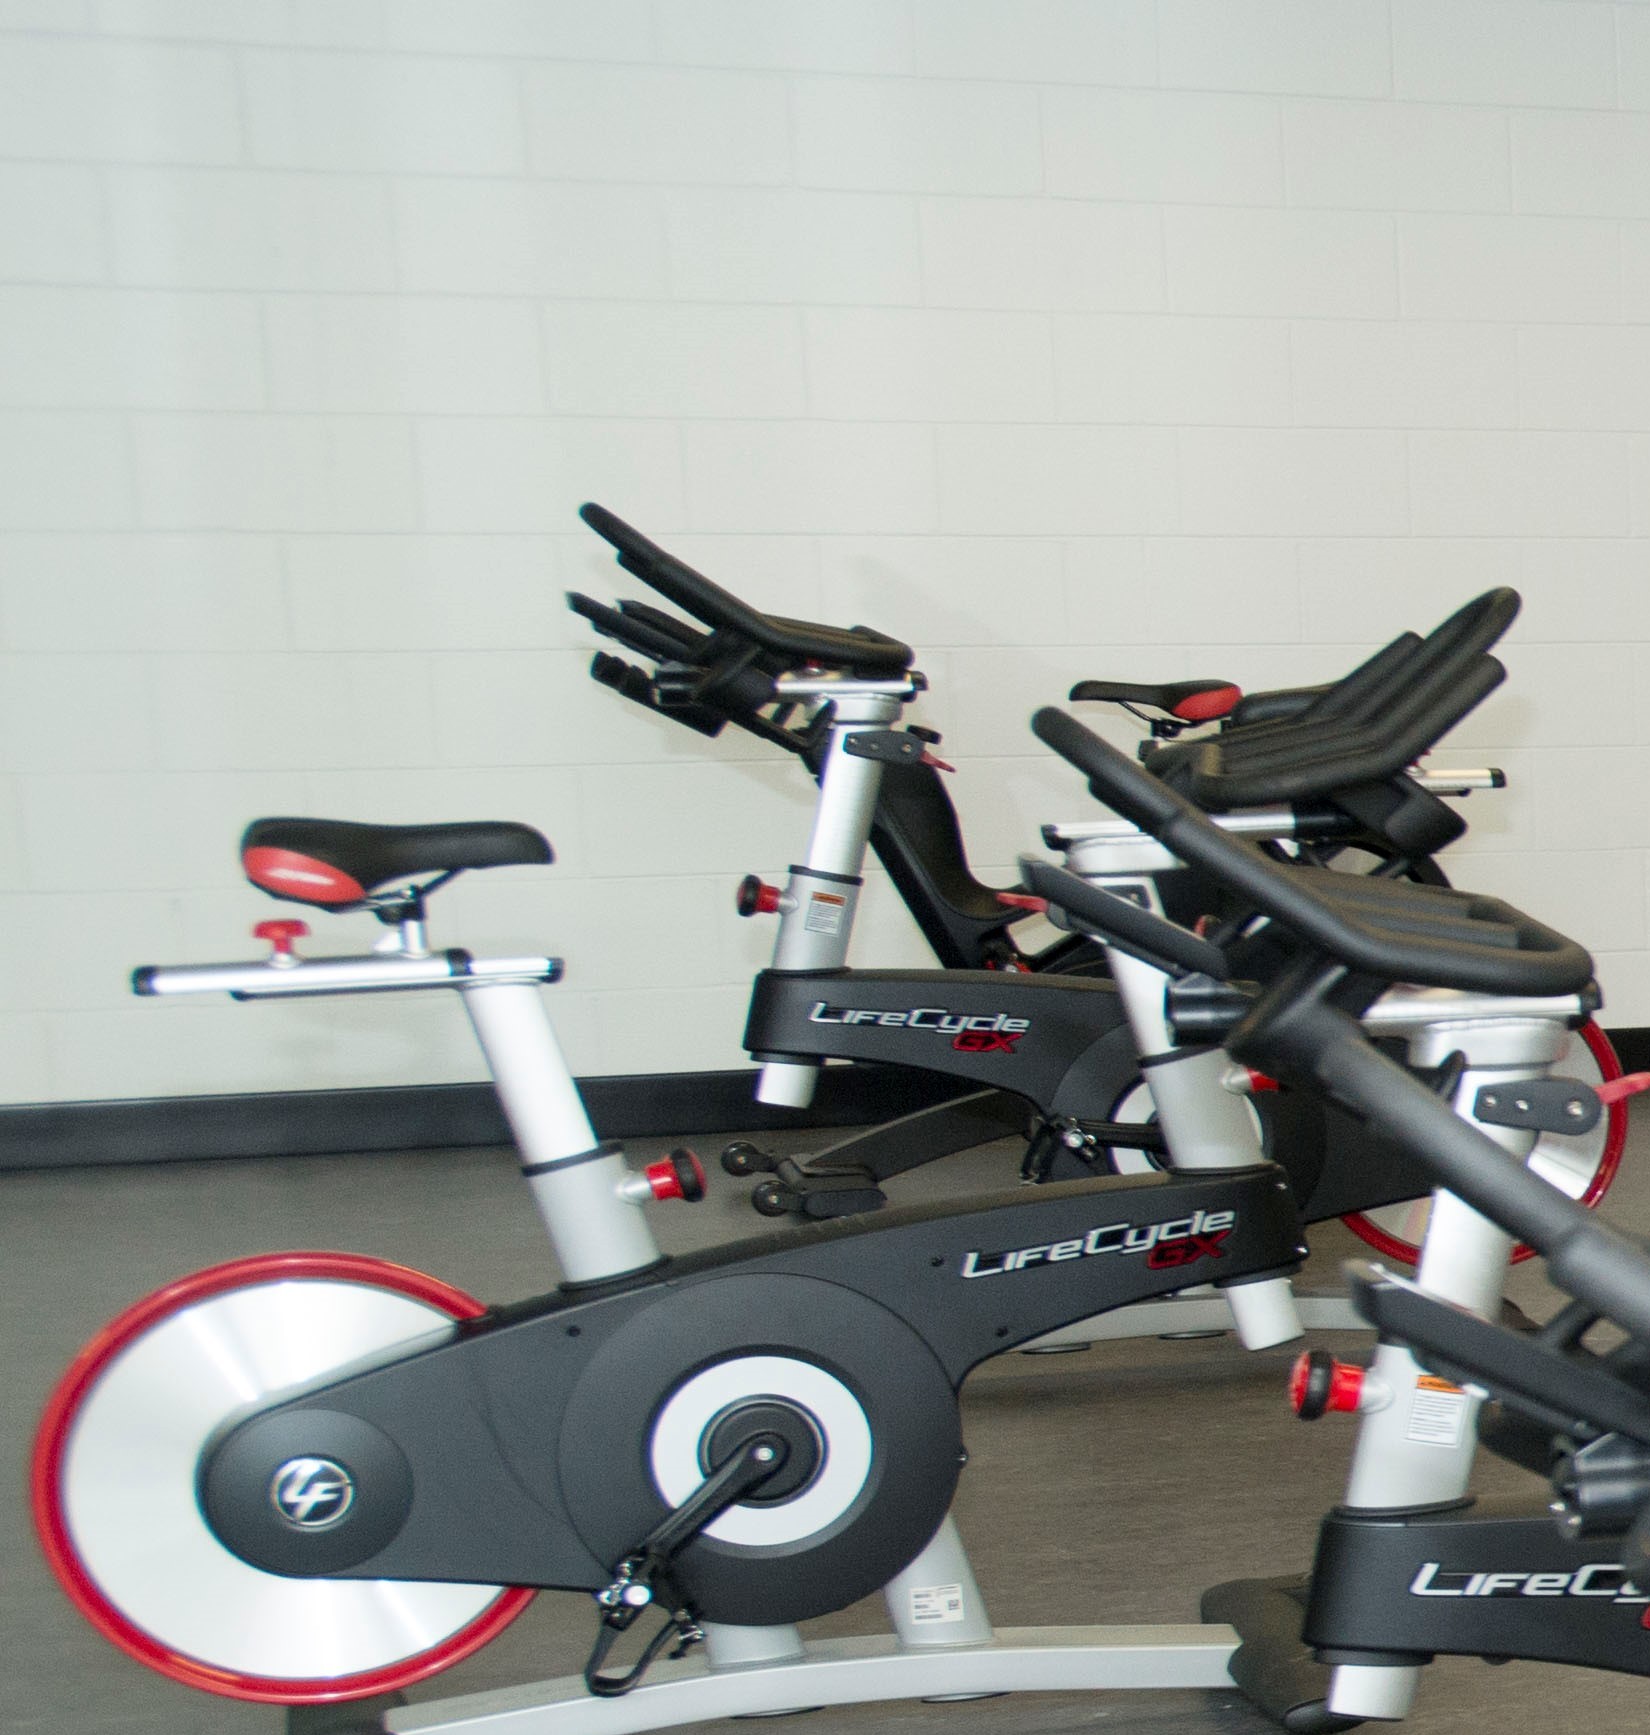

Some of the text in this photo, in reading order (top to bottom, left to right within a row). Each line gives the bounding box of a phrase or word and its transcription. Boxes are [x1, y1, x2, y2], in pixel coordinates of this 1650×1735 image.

[808, 1001, 1031, 1035] LifeCycle
[952, 1030, 1025, 1054] GX
[960, 1209, 1236, 1280] LifeCycle
[1146, 1231, 1230, 1271] GX
